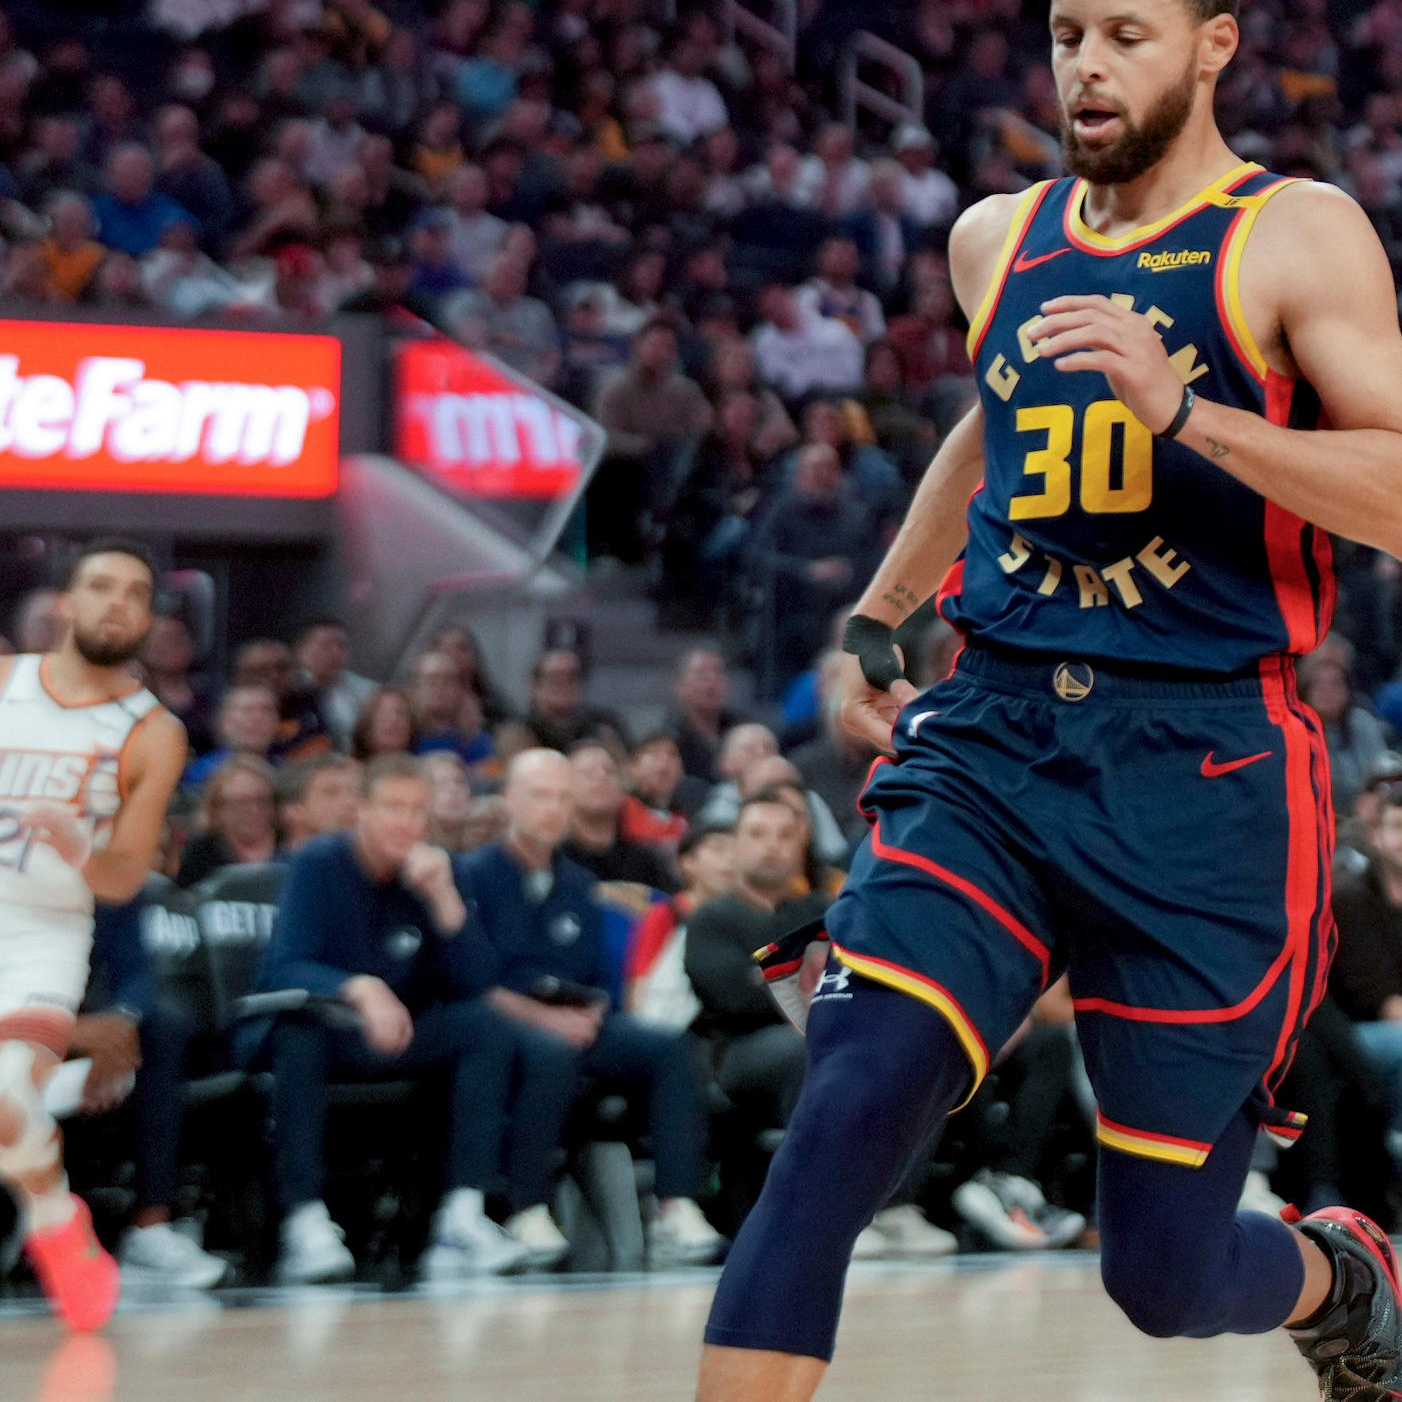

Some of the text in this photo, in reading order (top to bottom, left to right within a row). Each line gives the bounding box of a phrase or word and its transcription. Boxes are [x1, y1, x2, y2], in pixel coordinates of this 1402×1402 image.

[1137, 249, 1212, 273] Rakuten
[1009, 400, 1153, 520] 30
[998, 535, 1191, 609] STATE
